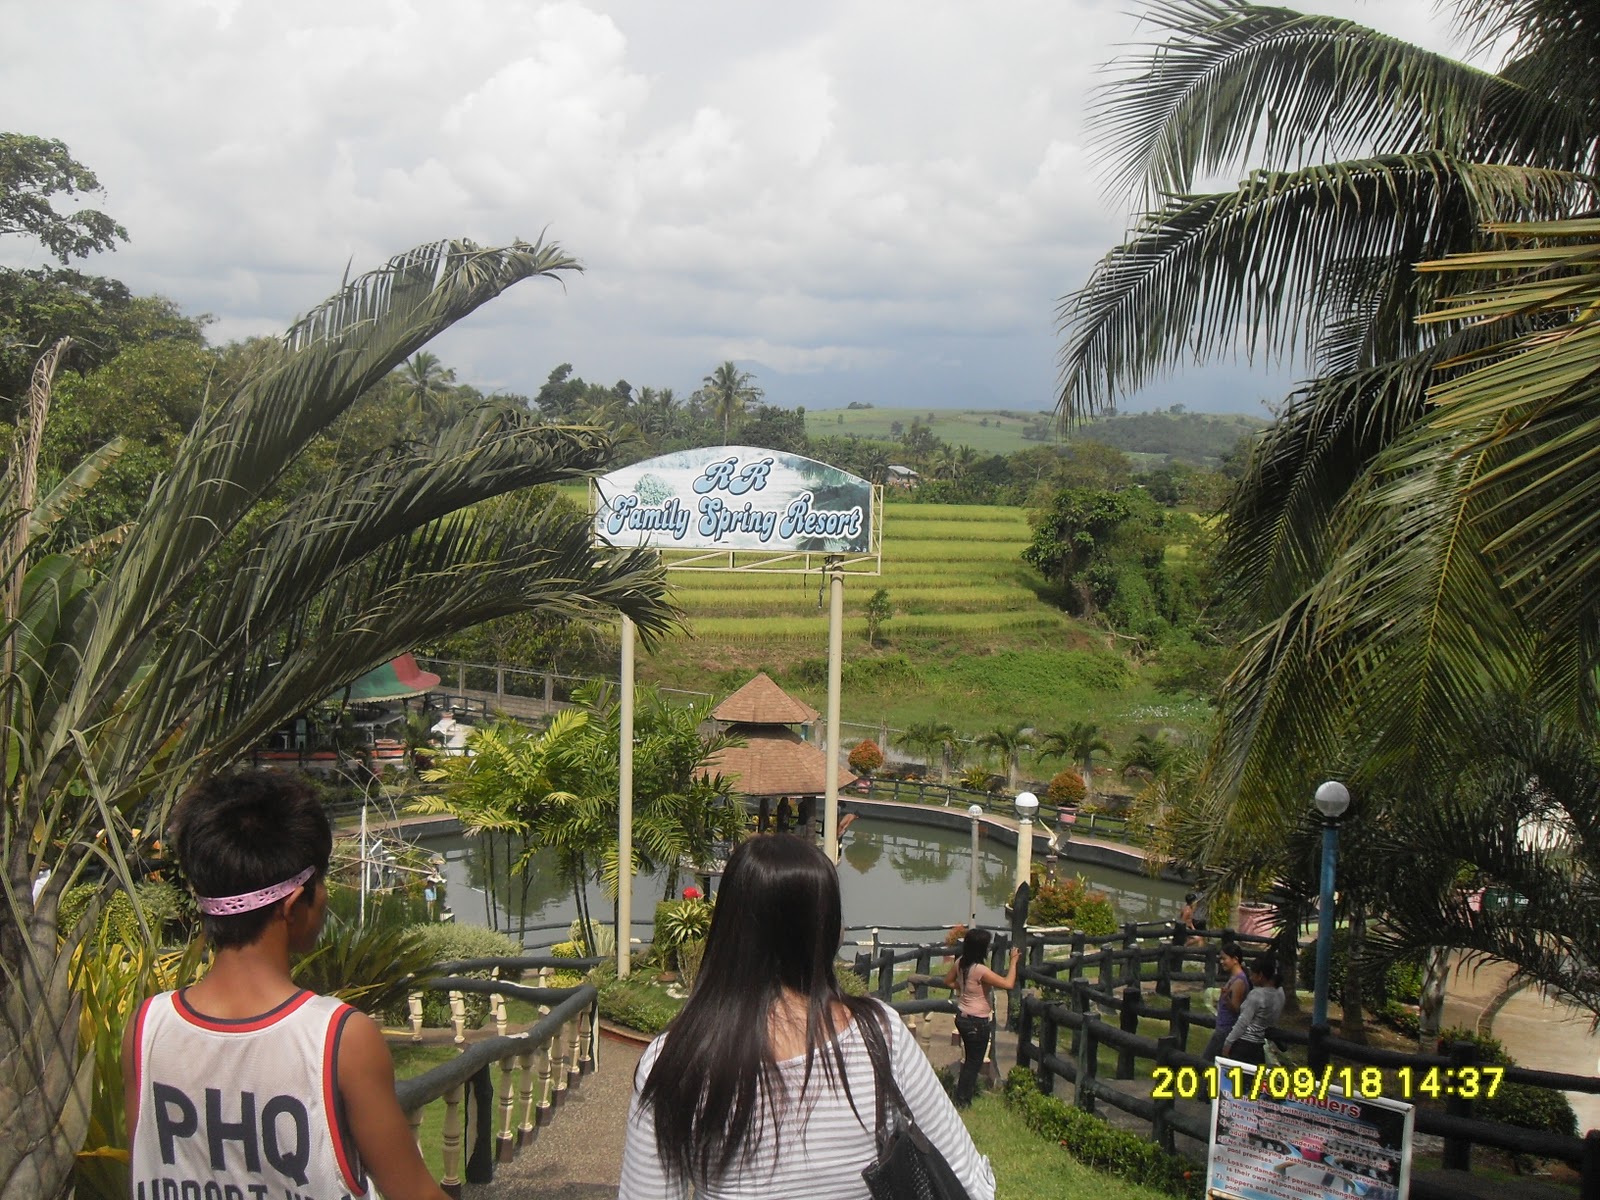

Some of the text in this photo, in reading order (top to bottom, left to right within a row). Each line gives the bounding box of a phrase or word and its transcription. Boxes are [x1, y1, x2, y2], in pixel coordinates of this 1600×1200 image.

[607, 493, 860, 541] Family Spring Resort
[1231, 1111, 1243, 1120] Use
[1246, 1115, 1257, 1124] the
[1259, 1119, 1274, 1129] slide
[1244, 1106, 1264, 1116] eating
[153, 1081, 310, 1186] PHQ
[1230, 1122, 1258, 1134] Children
[1261, 1130, 1277, 1139] must
[1290, 1138, 1310, 1148] under
[1312, 1144, 1323, 1152] the
[1326, 1147, 1367, 1164] supervision
[1226, 1146, 1240, 1155] pool
[1227, 1158, 1243, 1167] Loss
[1244, 1162, 1252, 1170] or
[1254, 1165, 1280, 1178] damage
[1291, 1177, 1322, 1190] personal
[1234, 1168, 1250, 1177] their
[1252, 1172, 1266, 1181] own
[1238, 1141, 1255, 1150] horse
[1285, 1153, 1311, 1166] pushing
[1313, 1161, 1326, 1169] and
[1328, 1165, 1352, 1178] running
[1354, 1173, 1378, 1185] around
[1380, 1181, 1392, 1189] the
[1226, 1175, 1253, 1189] Slippers
[1255, 1184, 1268, 1192] and
[1269, 1188, 1289, 1199] shoes
